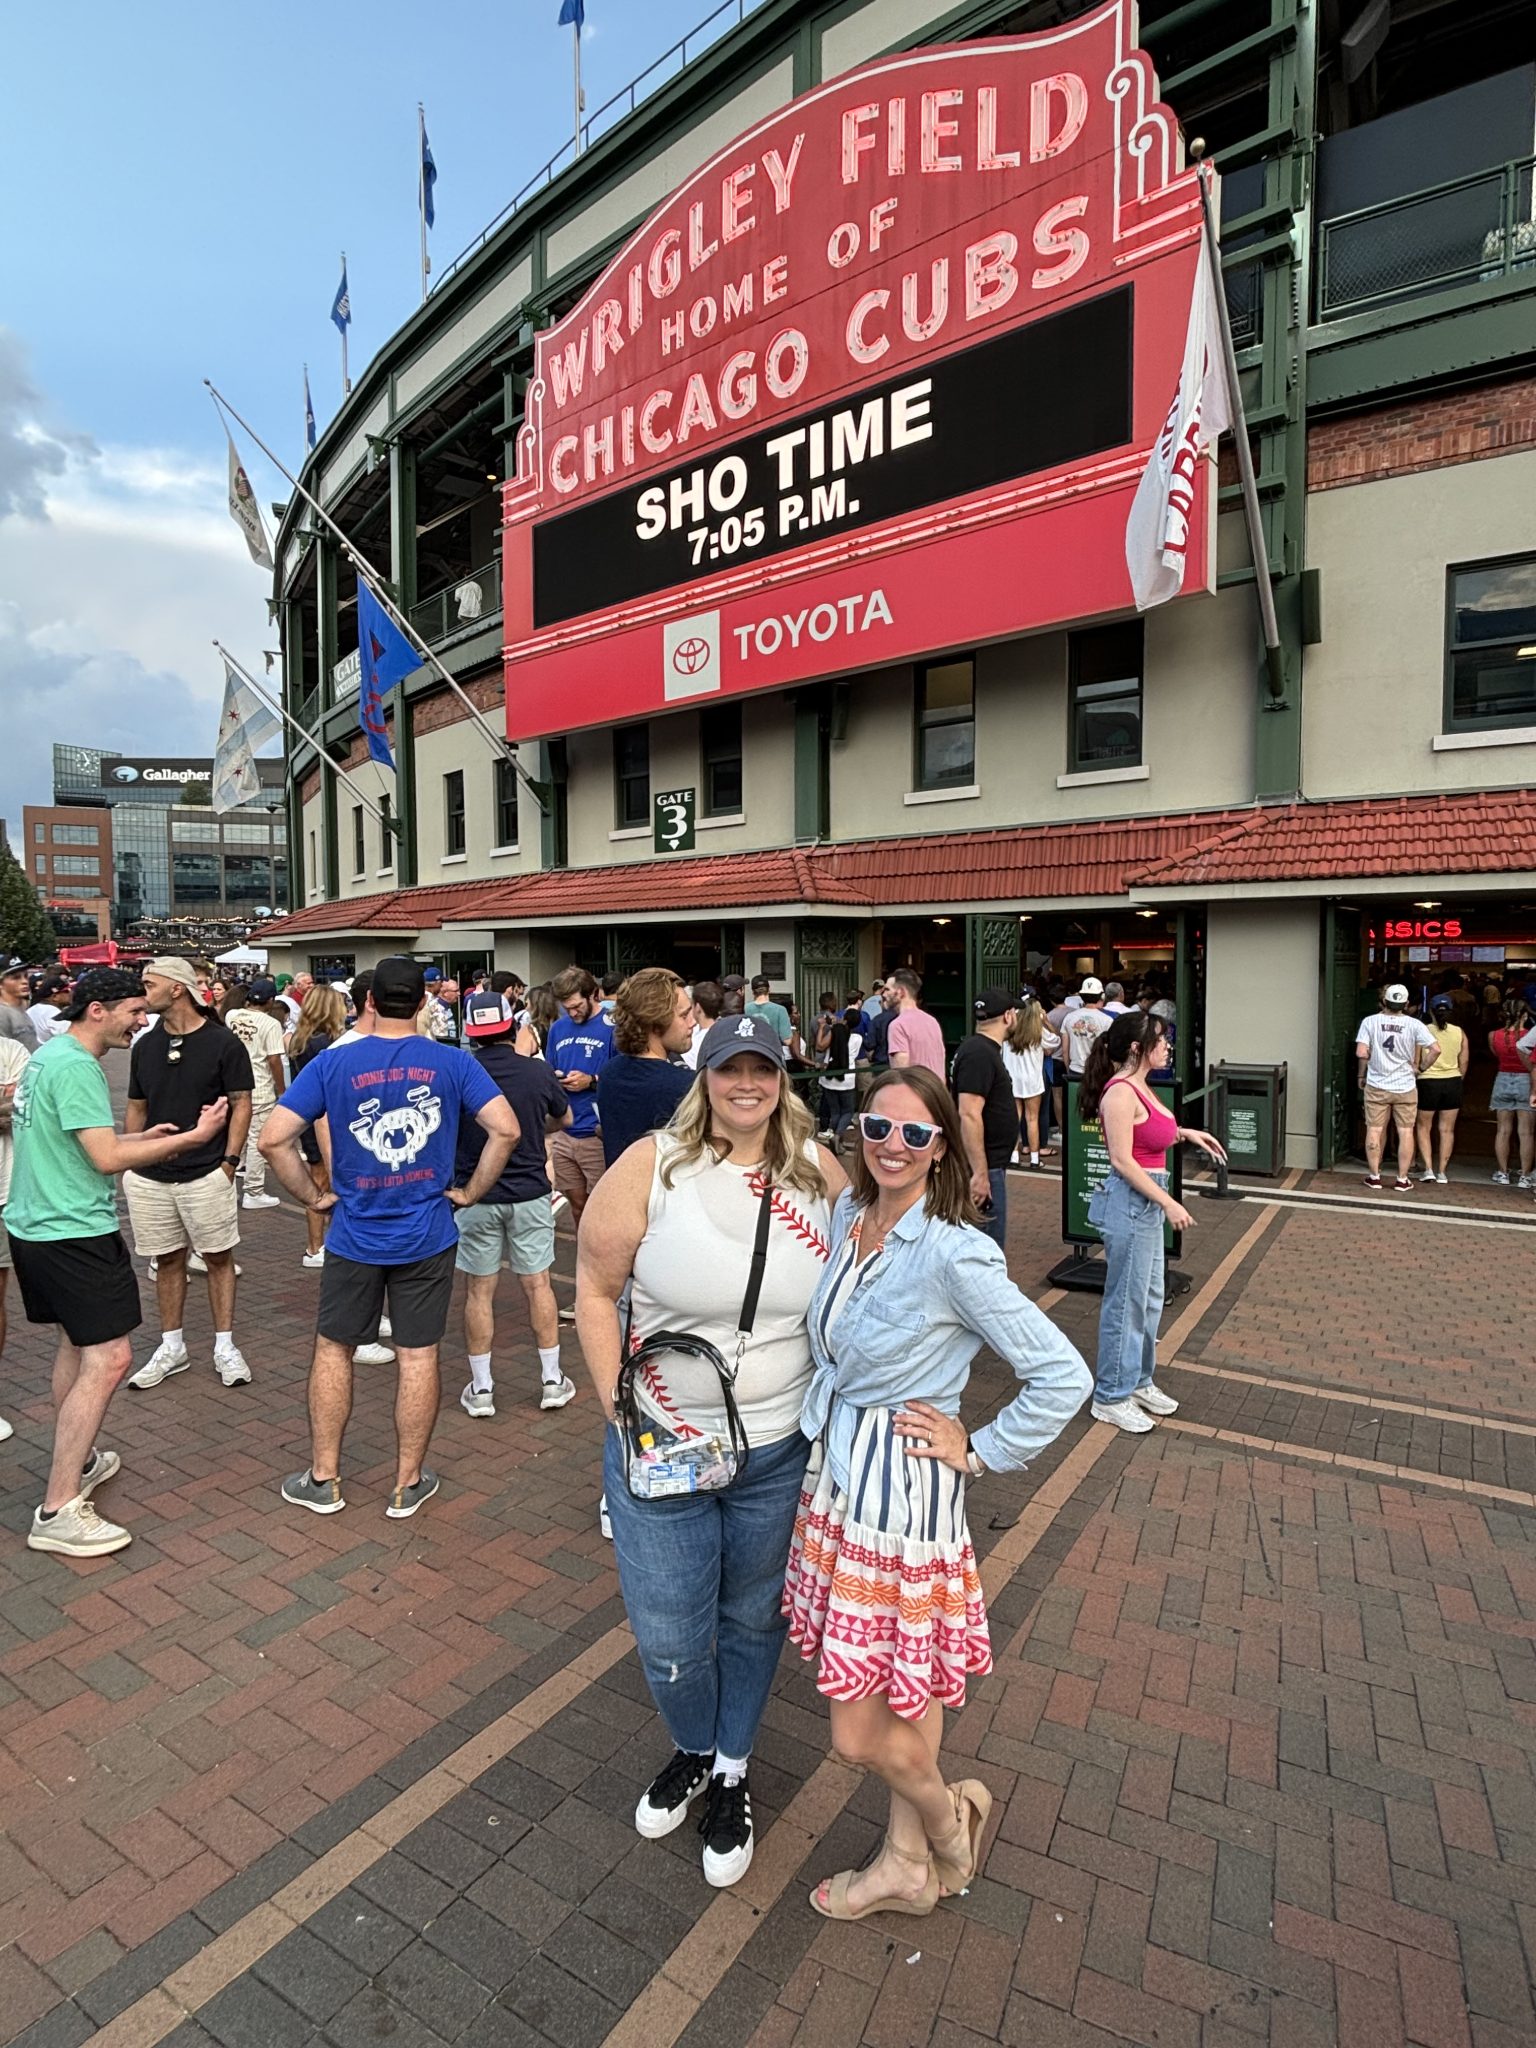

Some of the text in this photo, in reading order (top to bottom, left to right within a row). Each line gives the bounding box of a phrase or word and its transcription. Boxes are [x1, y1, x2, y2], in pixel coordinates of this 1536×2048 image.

[548, 72, 1089, 409] WRIGLEY FIELD
[661, 197, 898, 356] HOME OF
[548, 195, 1090, 494] CHICAGO CUBS
[635, 377, 933, 540] SHO TIME
[687, 478, 860, 566] 7:05 P.M.
[733, 588, 894, 661] TOYOTA
[142, 768, 211, 784] Gallagher
[656, 791, 693, 806] GATE
[661, 805, 688, 839] 3
[407, 1067, 436, 1083] NIGHT
[1382, 1035, 1395, 1052] 4
